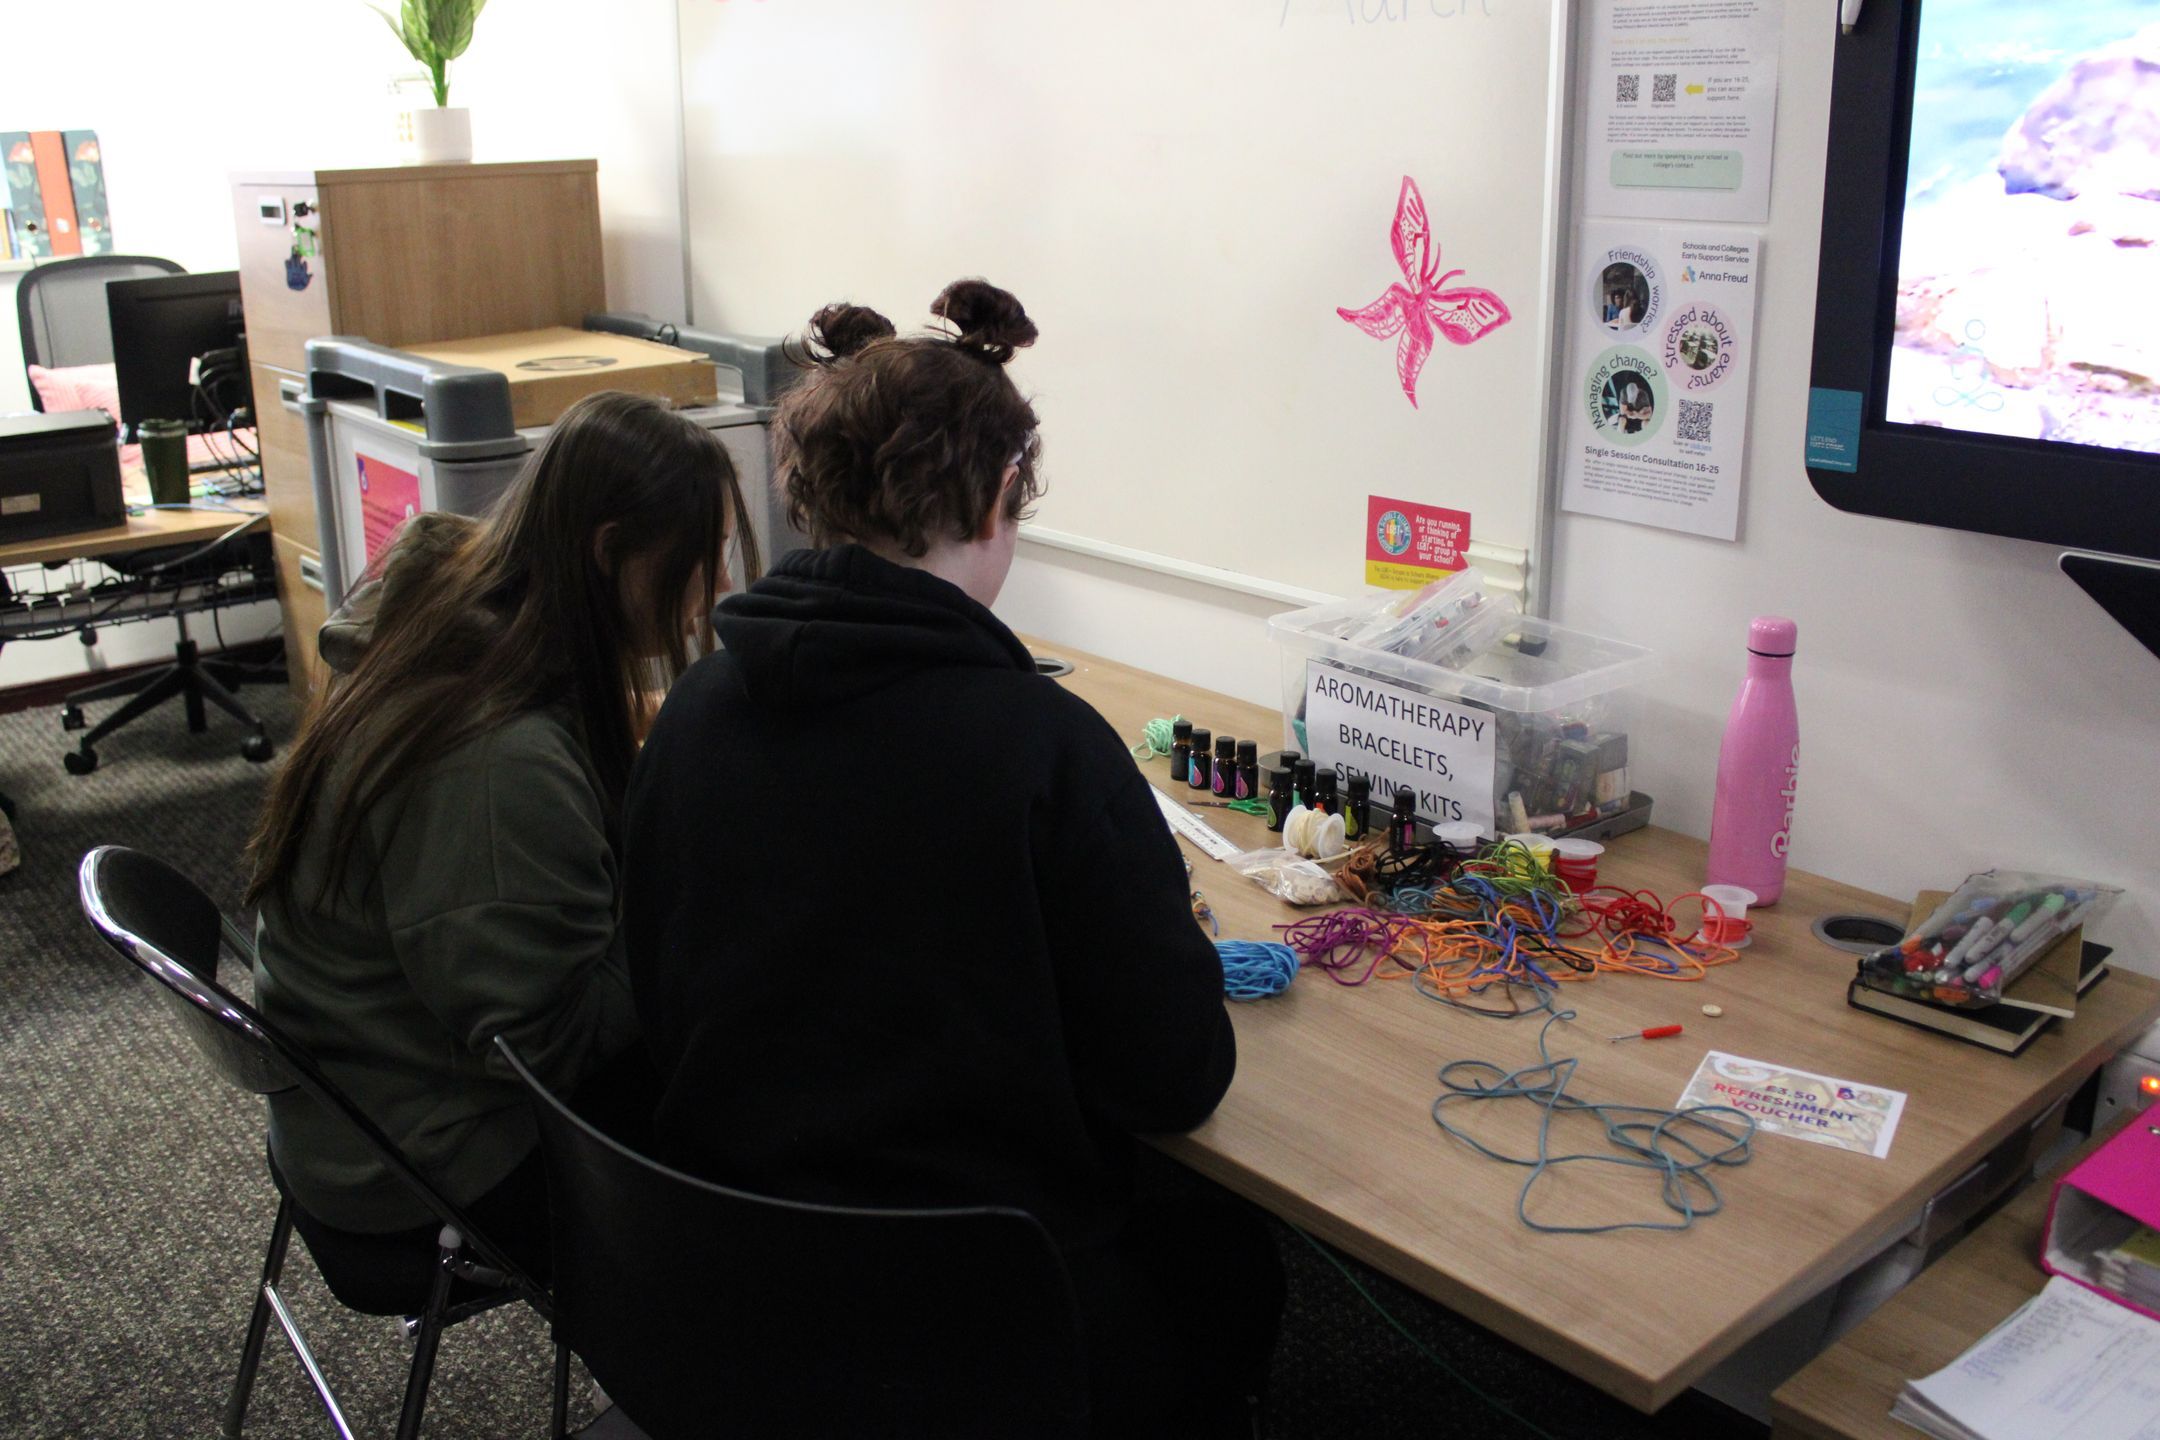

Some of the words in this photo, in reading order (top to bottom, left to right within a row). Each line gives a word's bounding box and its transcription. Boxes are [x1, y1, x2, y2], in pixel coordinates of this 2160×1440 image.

[1682, 242, 1707, 251] Schools
[1721, 244, 1749, 254] Colleges
[1682, 252, 1697, 260] Early
[1698, 253, 1723, 261] Support
[1724, 254, 1749, 263] Service
[1608, 249, 1655, 279] Friendship
[1699, 271, 1721, 281] Anna
[1723, 272, 1749, 283] Freud
[1665, 306, 1697, 368] Stressed
[1701, 310, 1733, 348] about
[1688, 353, 1730, 389] exams?
[1589, 366, 1610, 430] Managing
[1610, 354, 1658, 380] change?
[1585, 446, 1609, 458] Single
[1610, 450, 1640, 461] Session
[1642, 454, 1694, 471] Consultation
[1696, 463, 1720, 474] 16-25
[1416, 514, 1425, 524] Are
[1427, 518, 1437, 527] you
[1427, 526, 1449, 539] thinking
[1419, 552, 1431, 560] your
[1434, 554, 1454, 566] school?
[1434, 546, 1450, 556] group
[1452, 549, 1457, 557] in
[1315, 674, 1484, 741] AROMATHERAPY
[1339, 723, 1454, 782] BRACELETS,
[1420, 790, 1463, 821] KITS
[1713, 1082, 1857, 1121] REFRESHMENT
[1765, 1084, 1817, 1102] £3.50
[1730, 1099, 1830, 1128] VOUCHER
